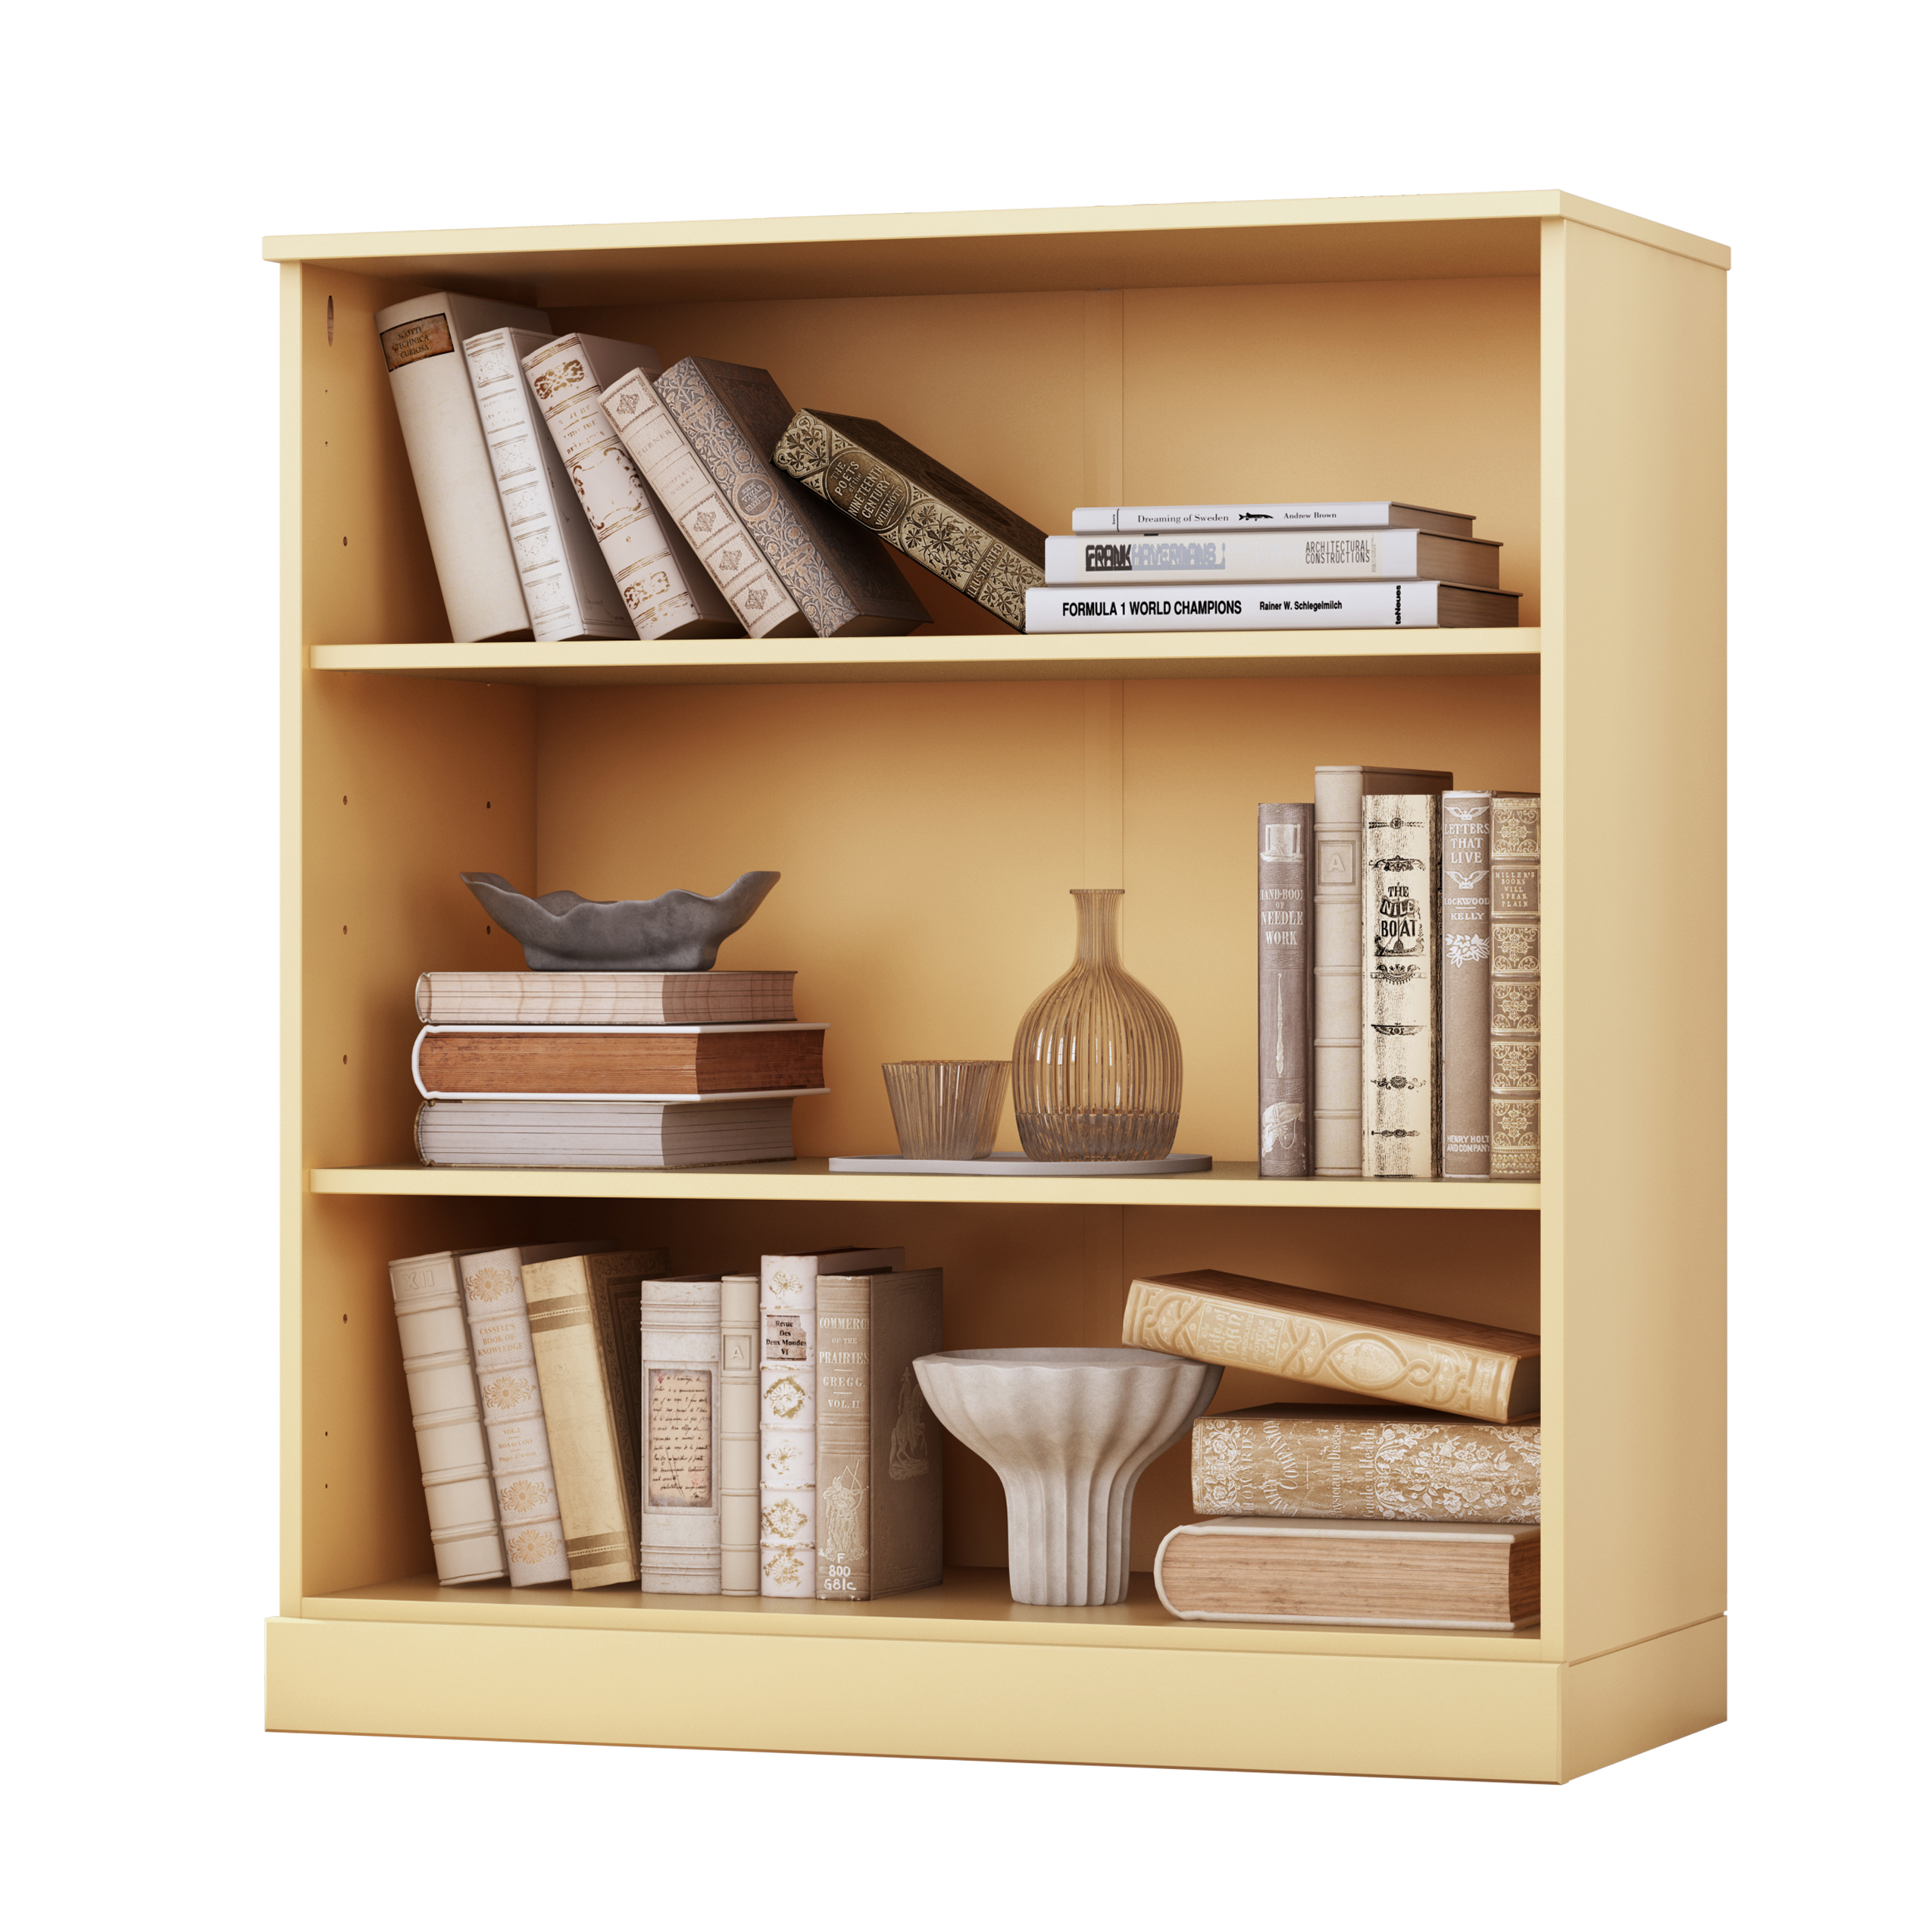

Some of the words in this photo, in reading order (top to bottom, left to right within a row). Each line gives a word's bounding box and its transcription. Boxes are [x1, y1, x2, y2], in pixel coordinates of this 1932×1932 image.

[398, 326, 423, 340] SCOTTI
[395, 334, 430, 349] TECHNICA
[400, 344, 430, 358] CURIOSA
[636, 429, 672, 457] TURNER
[661, 464, 696, 492] COMPLETE
[830, 461, 846, 480] THE
[670, 477, 694, 495] WORKS
[834, 461, 860, 496] POETS
[849, 483, 855, 492] of
[852, 473, 862, 485] the
[848, 464, 884, 517] NINETEENTH
[875, 486, 903, 526] WILLMOTT
[1137, 514, 1181, 524] Dreaming
[1194, 513, 1229, 522] Sweden
[1305, 539, 1370, 553] ARCHITECTURAL
[1086, 544, 1132, 571] FRANK
[1305, 551, 1371, 564] CONSTRUCTIONS
[967, 542, 1003, 598] ILLUSTRATED
[1062, 602, 1118, 616] FORMULA
[1121, 602, 1126, 615] 1
[1130, 601, 1171, 615] WORLD
[1174, 600, 1243, 615] CHAMPIONS
[1259, 601, 1282, 611] Rainer
[1283, 601, 1293, 610] W.
[1294, 600, 1343, 612] Schlegelmilch
[1444, 823, 1490, 835] LETTERS
[1450, 837, 1483, 849] THAT
[1327, 854, 1346, 871] A
[1451, 852, 1483, 864] LIVE
[1388, 886, 1409, 897] THE
[1381, 899, 1415, 915] NILE
[1444, 897, 1490, 905] LOCKWOOD
[1261, 911, 1303, 925] NEEDLE
[1450, 912, 1485, 921] KELLY
[1381, 919, 1418, 937] BOAT
[1265, 930, 1298, 945] WORK
[1447, 1135, 1469, 1143] HENRY
[1470, 1135, 1490, 1143] HOLT
[402, 1269, 434, 1291] XII
[483, 1335, 504, 1345] BOOK
[1252, 1319, 1265, 1361] MONTHS
[1266, 1328, 1279, 1357] YEAR
[730, 1345, 745, 1360] A
[819, 1351, 870, 1364] PRAIRIES
[823, 1376, 866, 1387] GREGG.
[827, 1399, 850, 1408] VOL.
[852, 1400, 861, 1408] II
[1327, 1424, 1343, 1461] Disease
[1359, 1428, 1375, 1468] Health
[1240, 1427, 1255, 1512] HOWARD'S
[1360, 1485, 1377, 1518] Guide
[837, 1552, 846, 1564] F
[829, 1565, 851, 1577] 800
